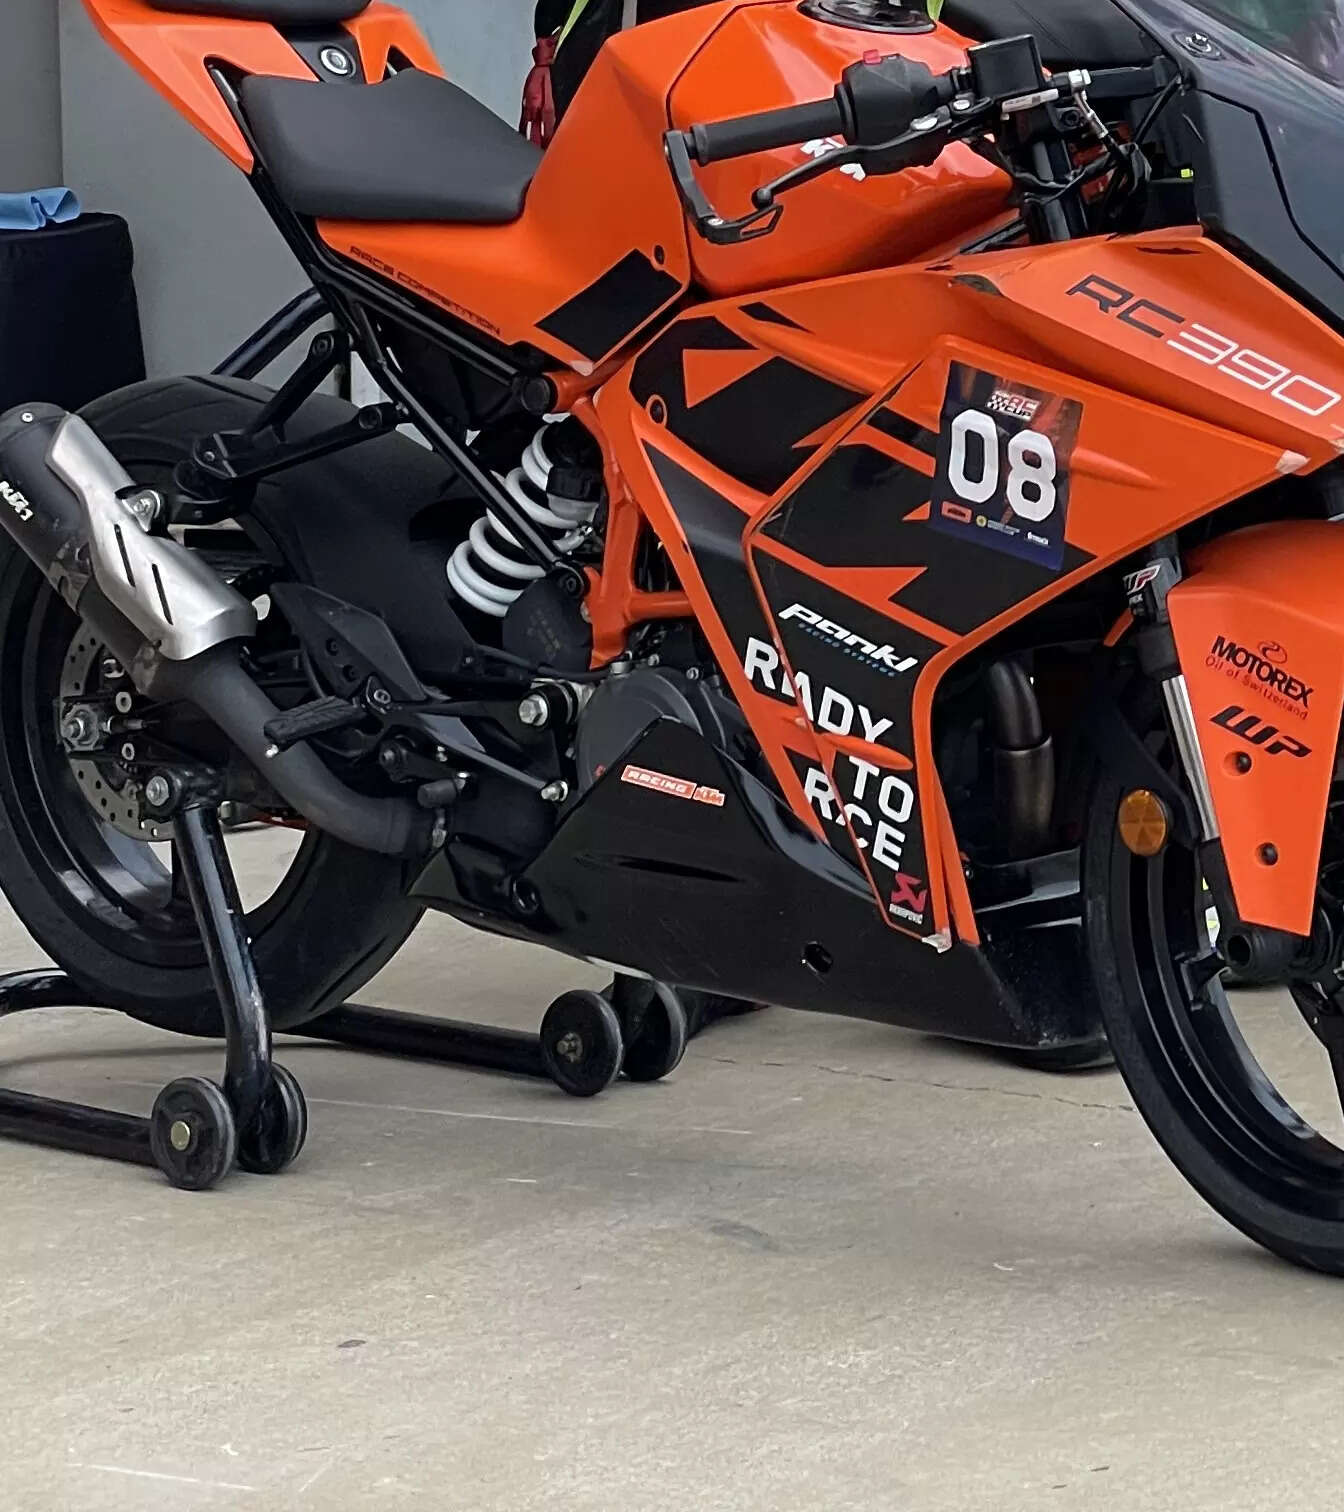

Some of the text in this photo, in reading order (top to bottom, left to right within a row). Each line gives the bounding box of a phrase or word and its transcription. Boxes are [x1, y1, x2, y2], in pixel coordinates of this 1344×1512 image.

[948, 409, 1056, 522] 08
[1205, 654, 1310, 721] Oil of Switzerland
[1210, 634, 1315, 710] MOTOREX
[627, 770, 689, 795] RACING
[849, 754, 915, 823] TO
[804, 767, 906, 872] RCE
